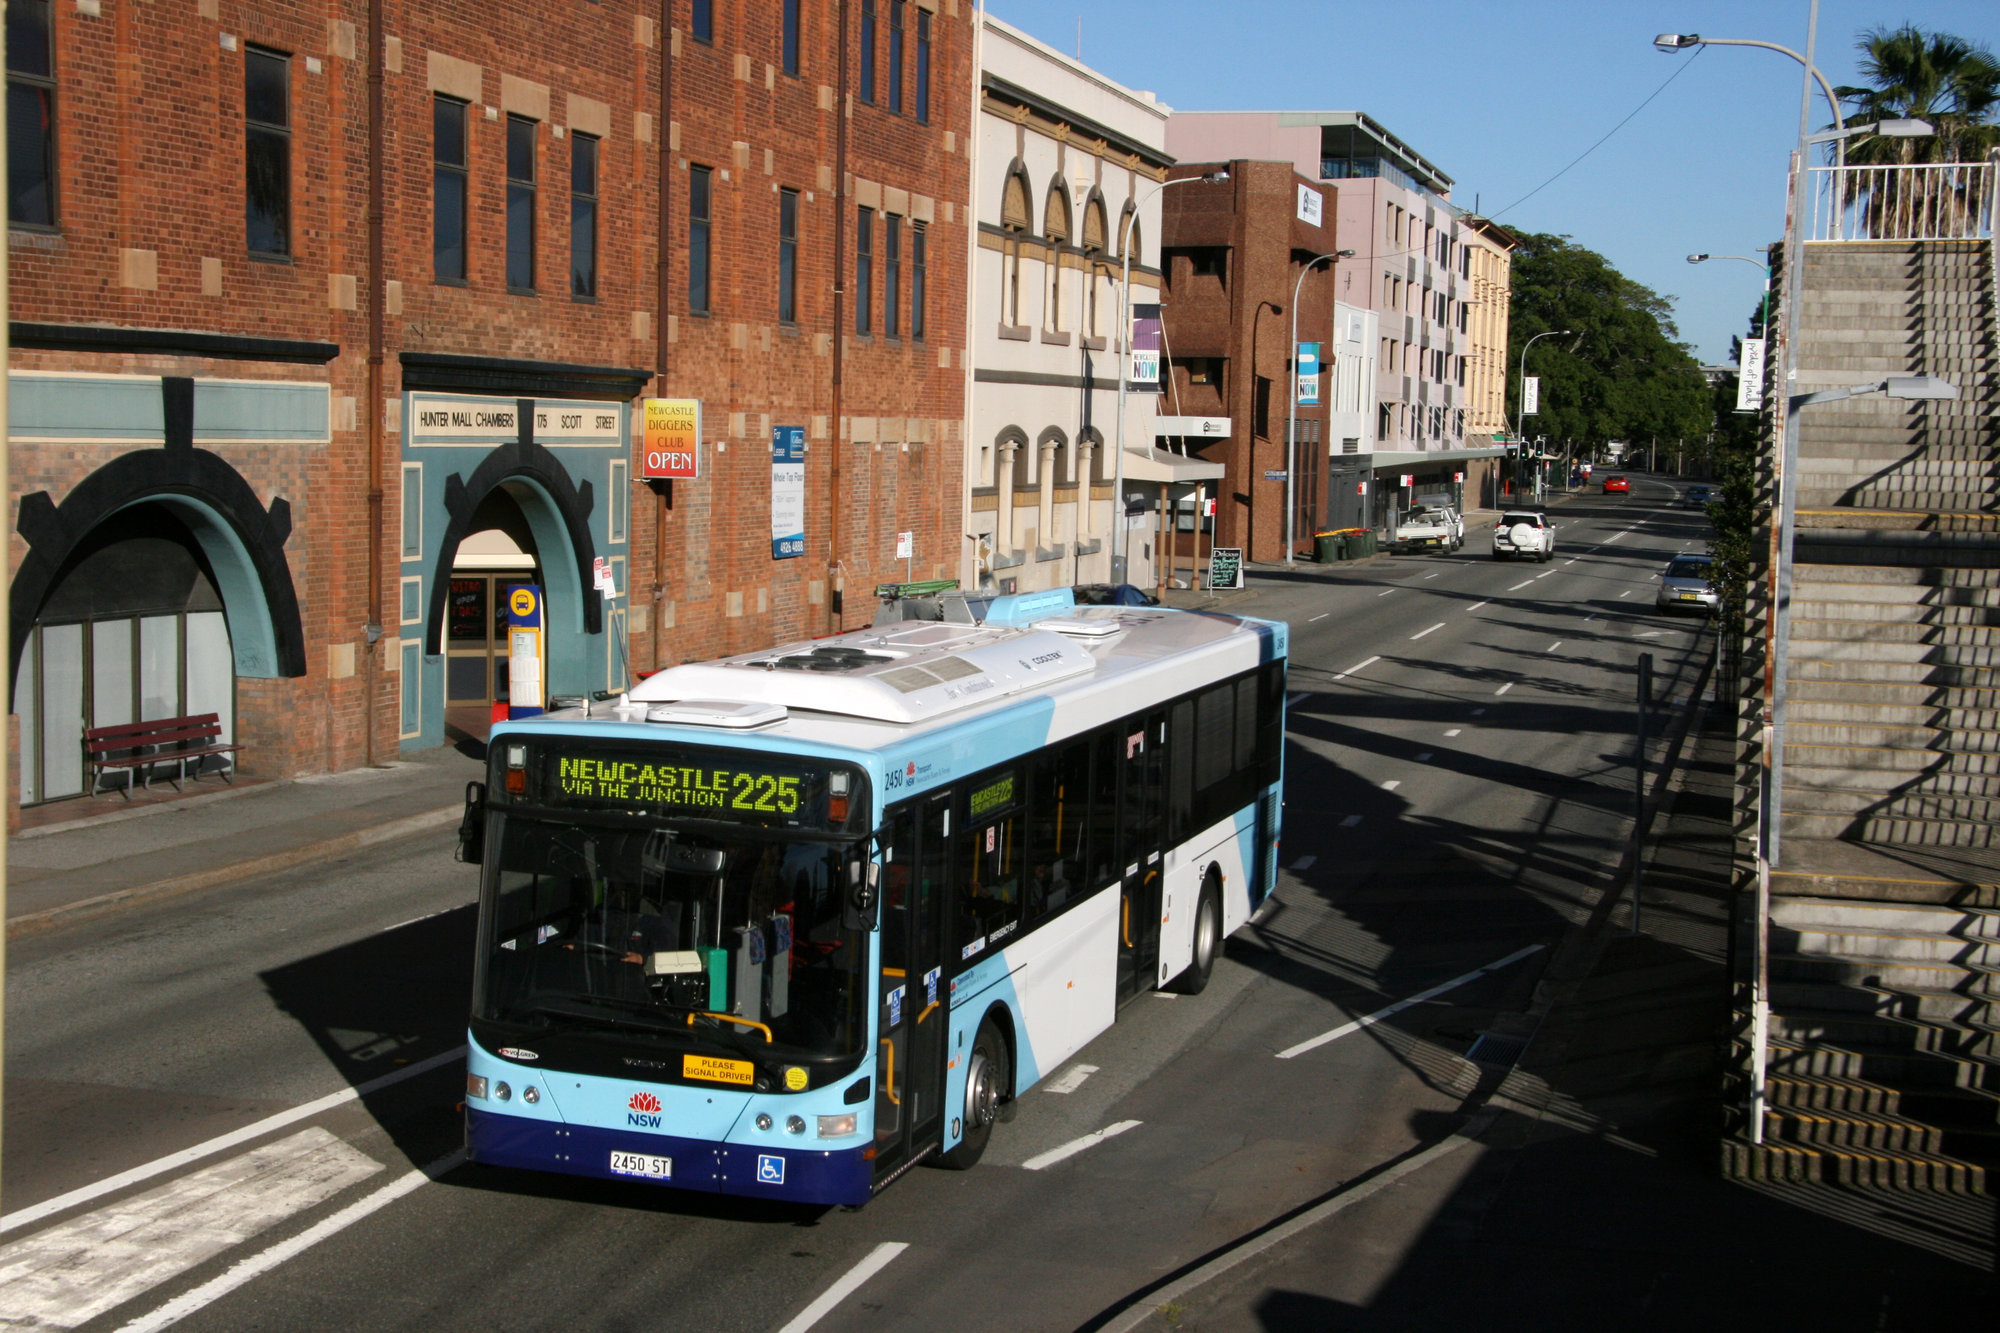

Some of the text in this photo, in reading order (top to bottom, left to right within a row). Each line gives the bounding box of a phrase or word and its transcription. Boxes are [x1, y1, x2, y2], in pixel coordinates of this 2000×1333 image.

[1134, 361, 1157, 378] NOW
[1300, 384, 1316, 396] NOW
[648, 406, 694, 416] NEWCASTLE
[420, 411, 616, 430] HUNTER MALL CHAMBERS 175 SCOTT STREET
[648, 420, 694, 431] DIGGERS
[657, 436, 684, 448] CLUB
[647, 451, 693, 470] OPEN
[560, 758, 730, 792] NEWCASTLE
[885, 769, 903, 791] 2450
[562, 779, 723, 807] VIA THE JUNCTION
[732, 773, 800, 813] 225
[702, 1060, 735, 1071] PLEASE
[685, 1067, 752, 1082] SIGNAL DRIVER
[628, 1113, 662, 1128] NSW
[613, 1154, 645, 1171] 2450
